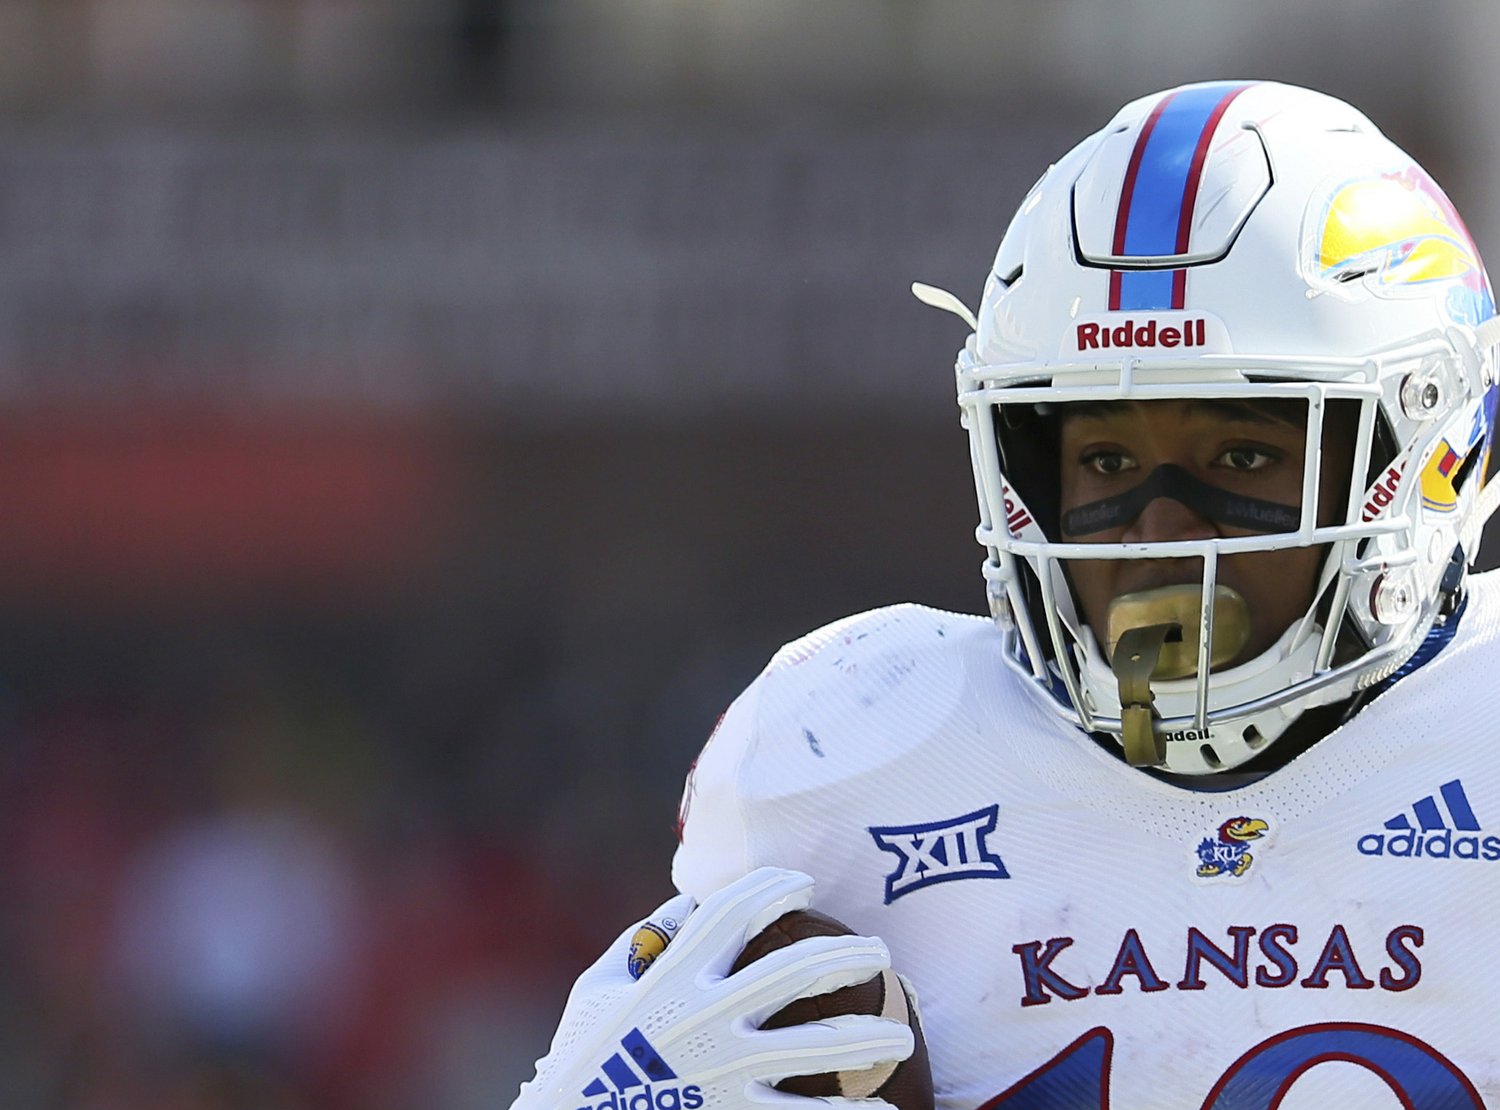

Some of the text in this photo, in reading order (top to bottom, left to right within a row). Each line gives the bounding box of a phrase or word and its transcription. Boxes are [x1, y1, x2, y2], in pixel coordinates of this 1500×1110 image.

[1076, 319, 1206, 351] Riddell
[1213, 846, 1237, 864] KU
[1012, 924, 1425, 1007] KANSAS
